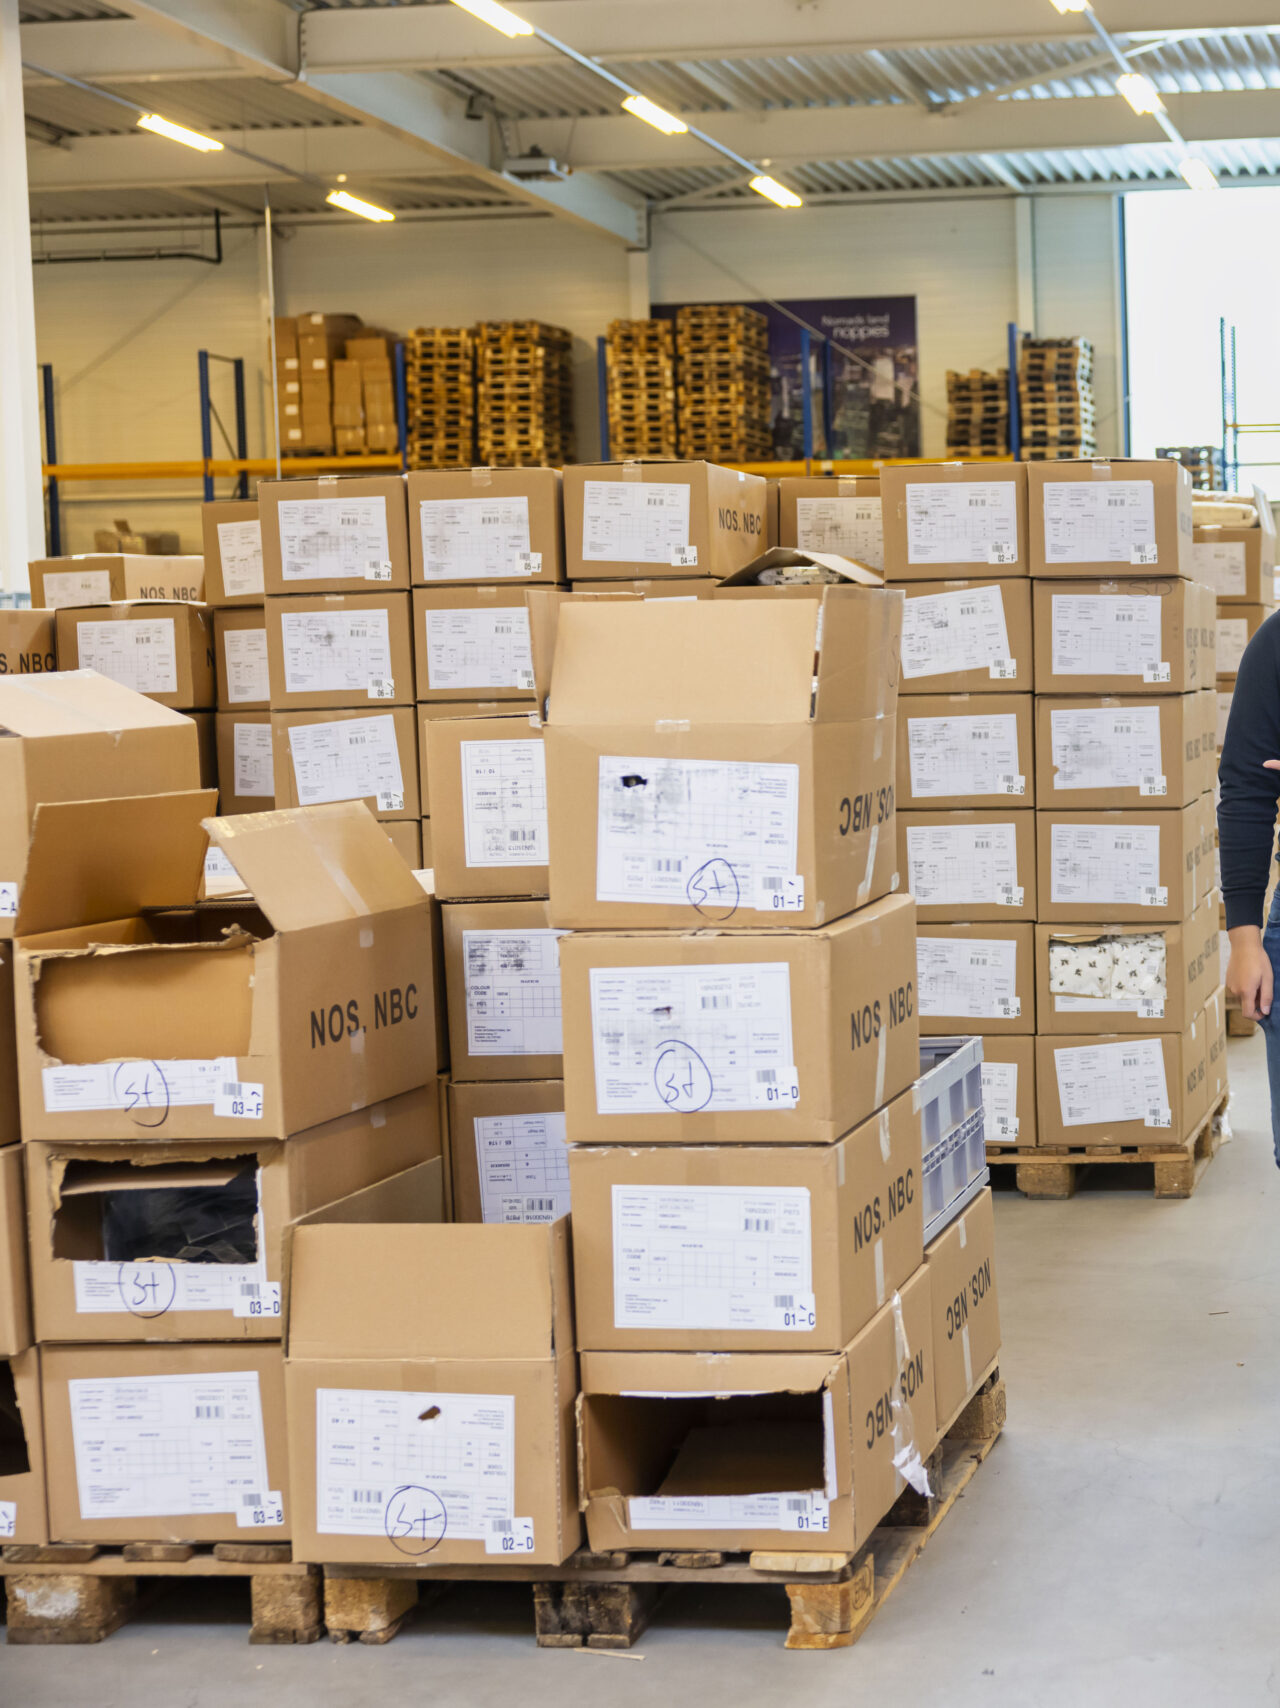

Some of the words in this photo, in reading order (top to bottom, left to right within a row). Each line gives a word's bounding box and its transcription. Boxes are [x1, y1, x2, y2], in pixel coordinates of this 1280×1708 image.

[832, 326, 890, 341] noppies
[718, 508, 741, 532] NOS.
[743, 511, 761, 536] NBC
[173, 587, 197, 600] NBC
[19, 653, 54, 672] NBC
[839, 792, 873, 836] NBC
[773, 895, 804, 908] 01-F
[888, 981, 913, 1030] NBC
[310, 1000, 367, 1049] NOS.
[374, 983, 418, 1030] NBC
[767, 1086, 799, 1101] 01-D
[232, 1101, 262, 1116] 03-F
[853, 1196, 886, 1254] NOS.
[888, 1168, 914, 1221] NBC
[968, 1257, 991, 1308] NOS.
[250, 1301, 280, 1315] 03-D
[946, 1288, 968, 1341] NBC
[784, 1312, 815, 1326] 01-C
[866, 1385, 893, 1450] NBC
[253, 1510, 284, 1524] 03-B
[797, 1516, 829, 1529] 01-E
[502, 1536, 534, 1551] 02-D
